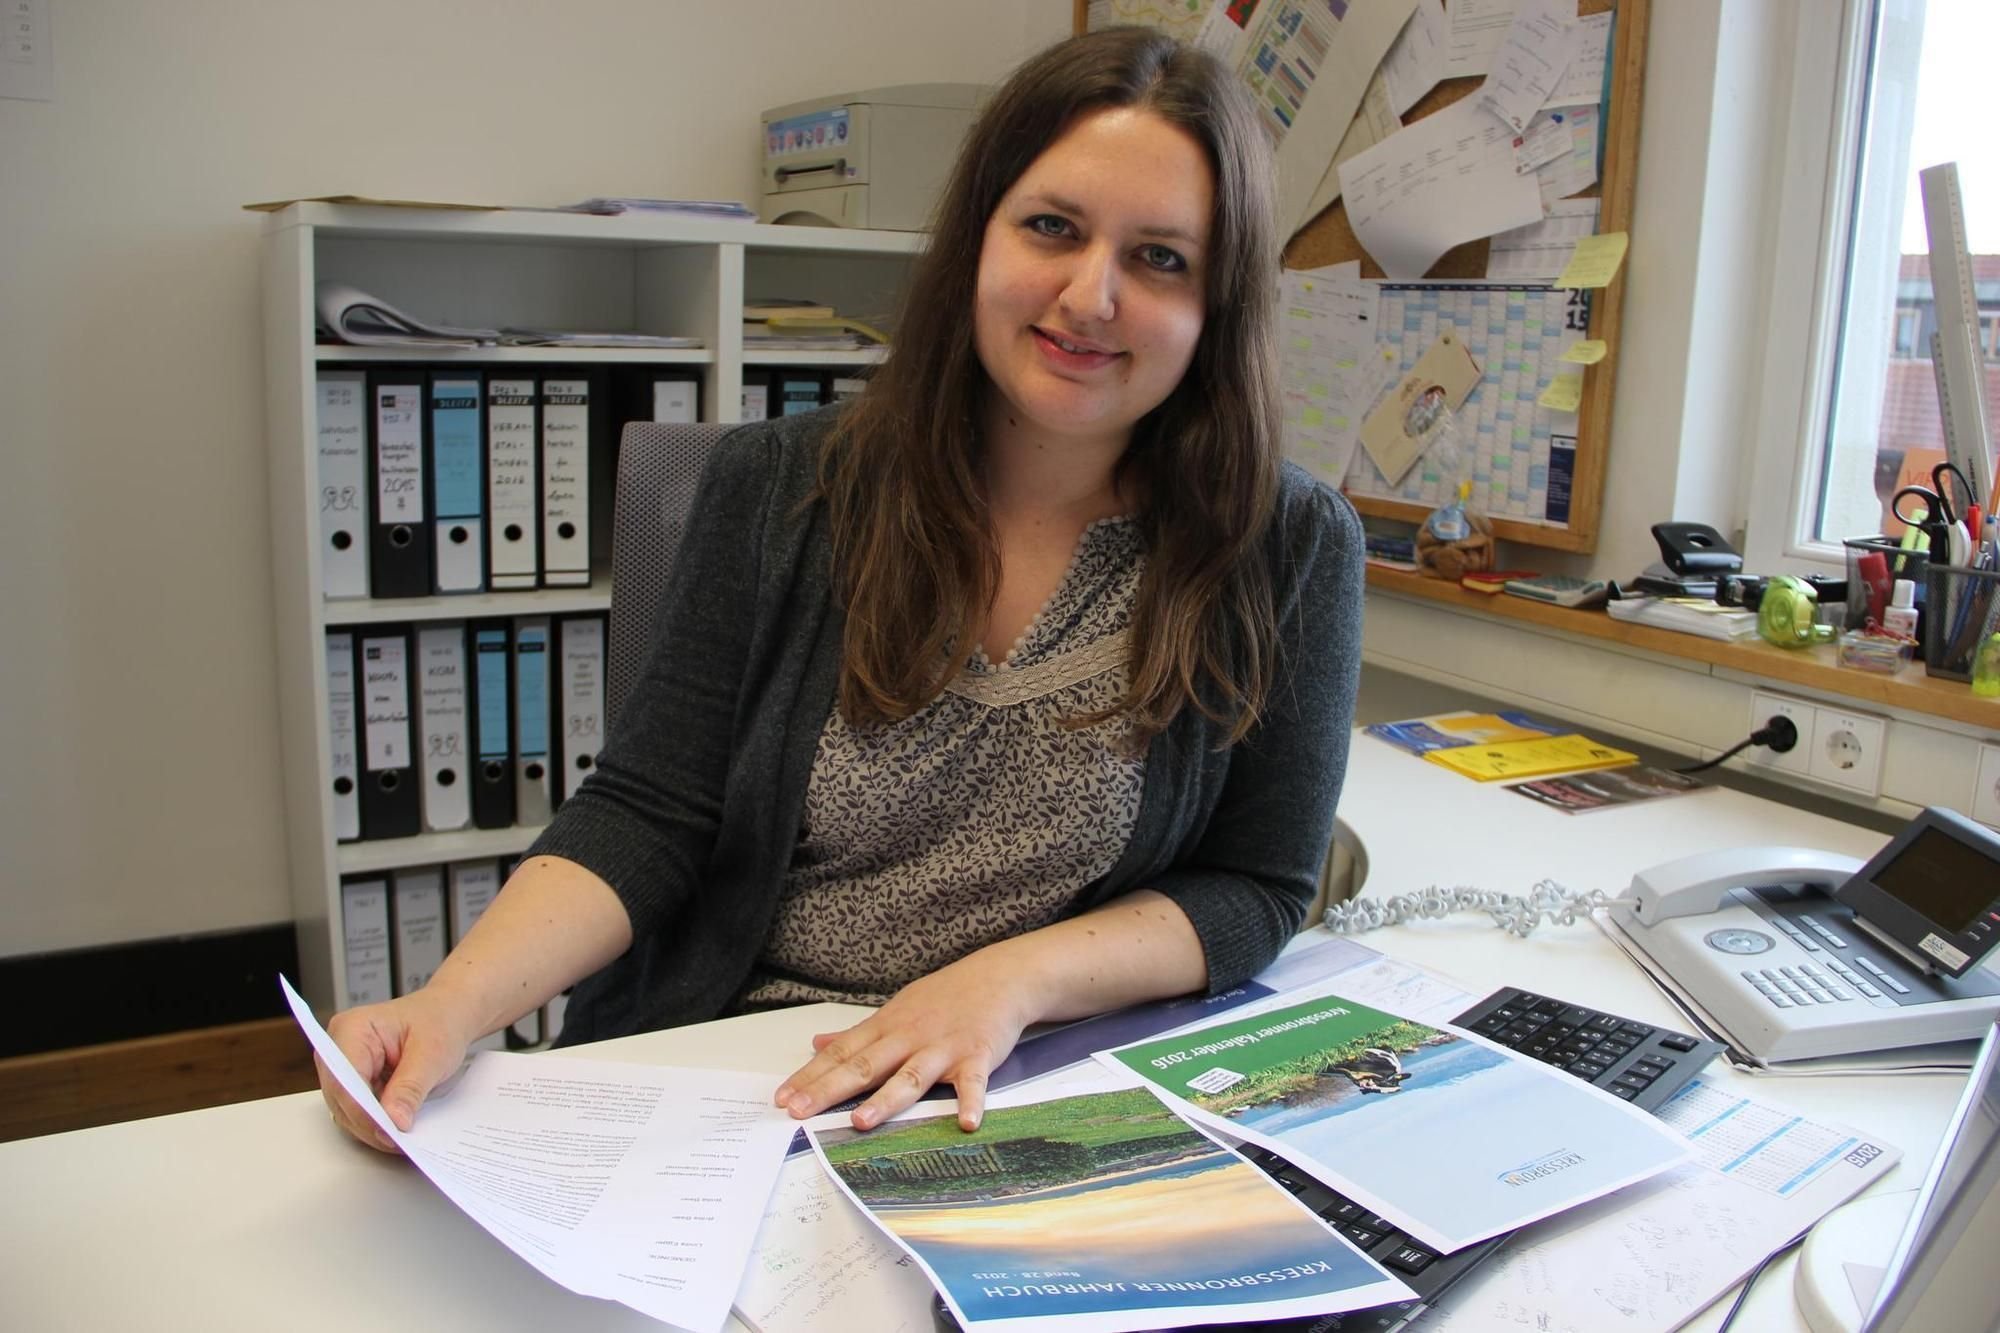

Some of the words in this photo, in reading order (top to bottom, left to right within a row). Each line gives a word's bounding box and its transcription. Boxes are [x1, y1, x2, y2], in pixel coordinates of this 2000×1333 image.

[1255, 1005, 1352, 1038] Kressbronner
[1190, 1031, 1261, 1056] Kalender
[1150, 1050, 1193, 1070] 2016
[1846, 1143, 1881, 1168] 2015
[971, 1272, 1009, 1280] 2015
[1134, 1260, 1333, 1293] KRESSBRONNER
[983, 1281, 1126, 1299] JAHRBUCH
